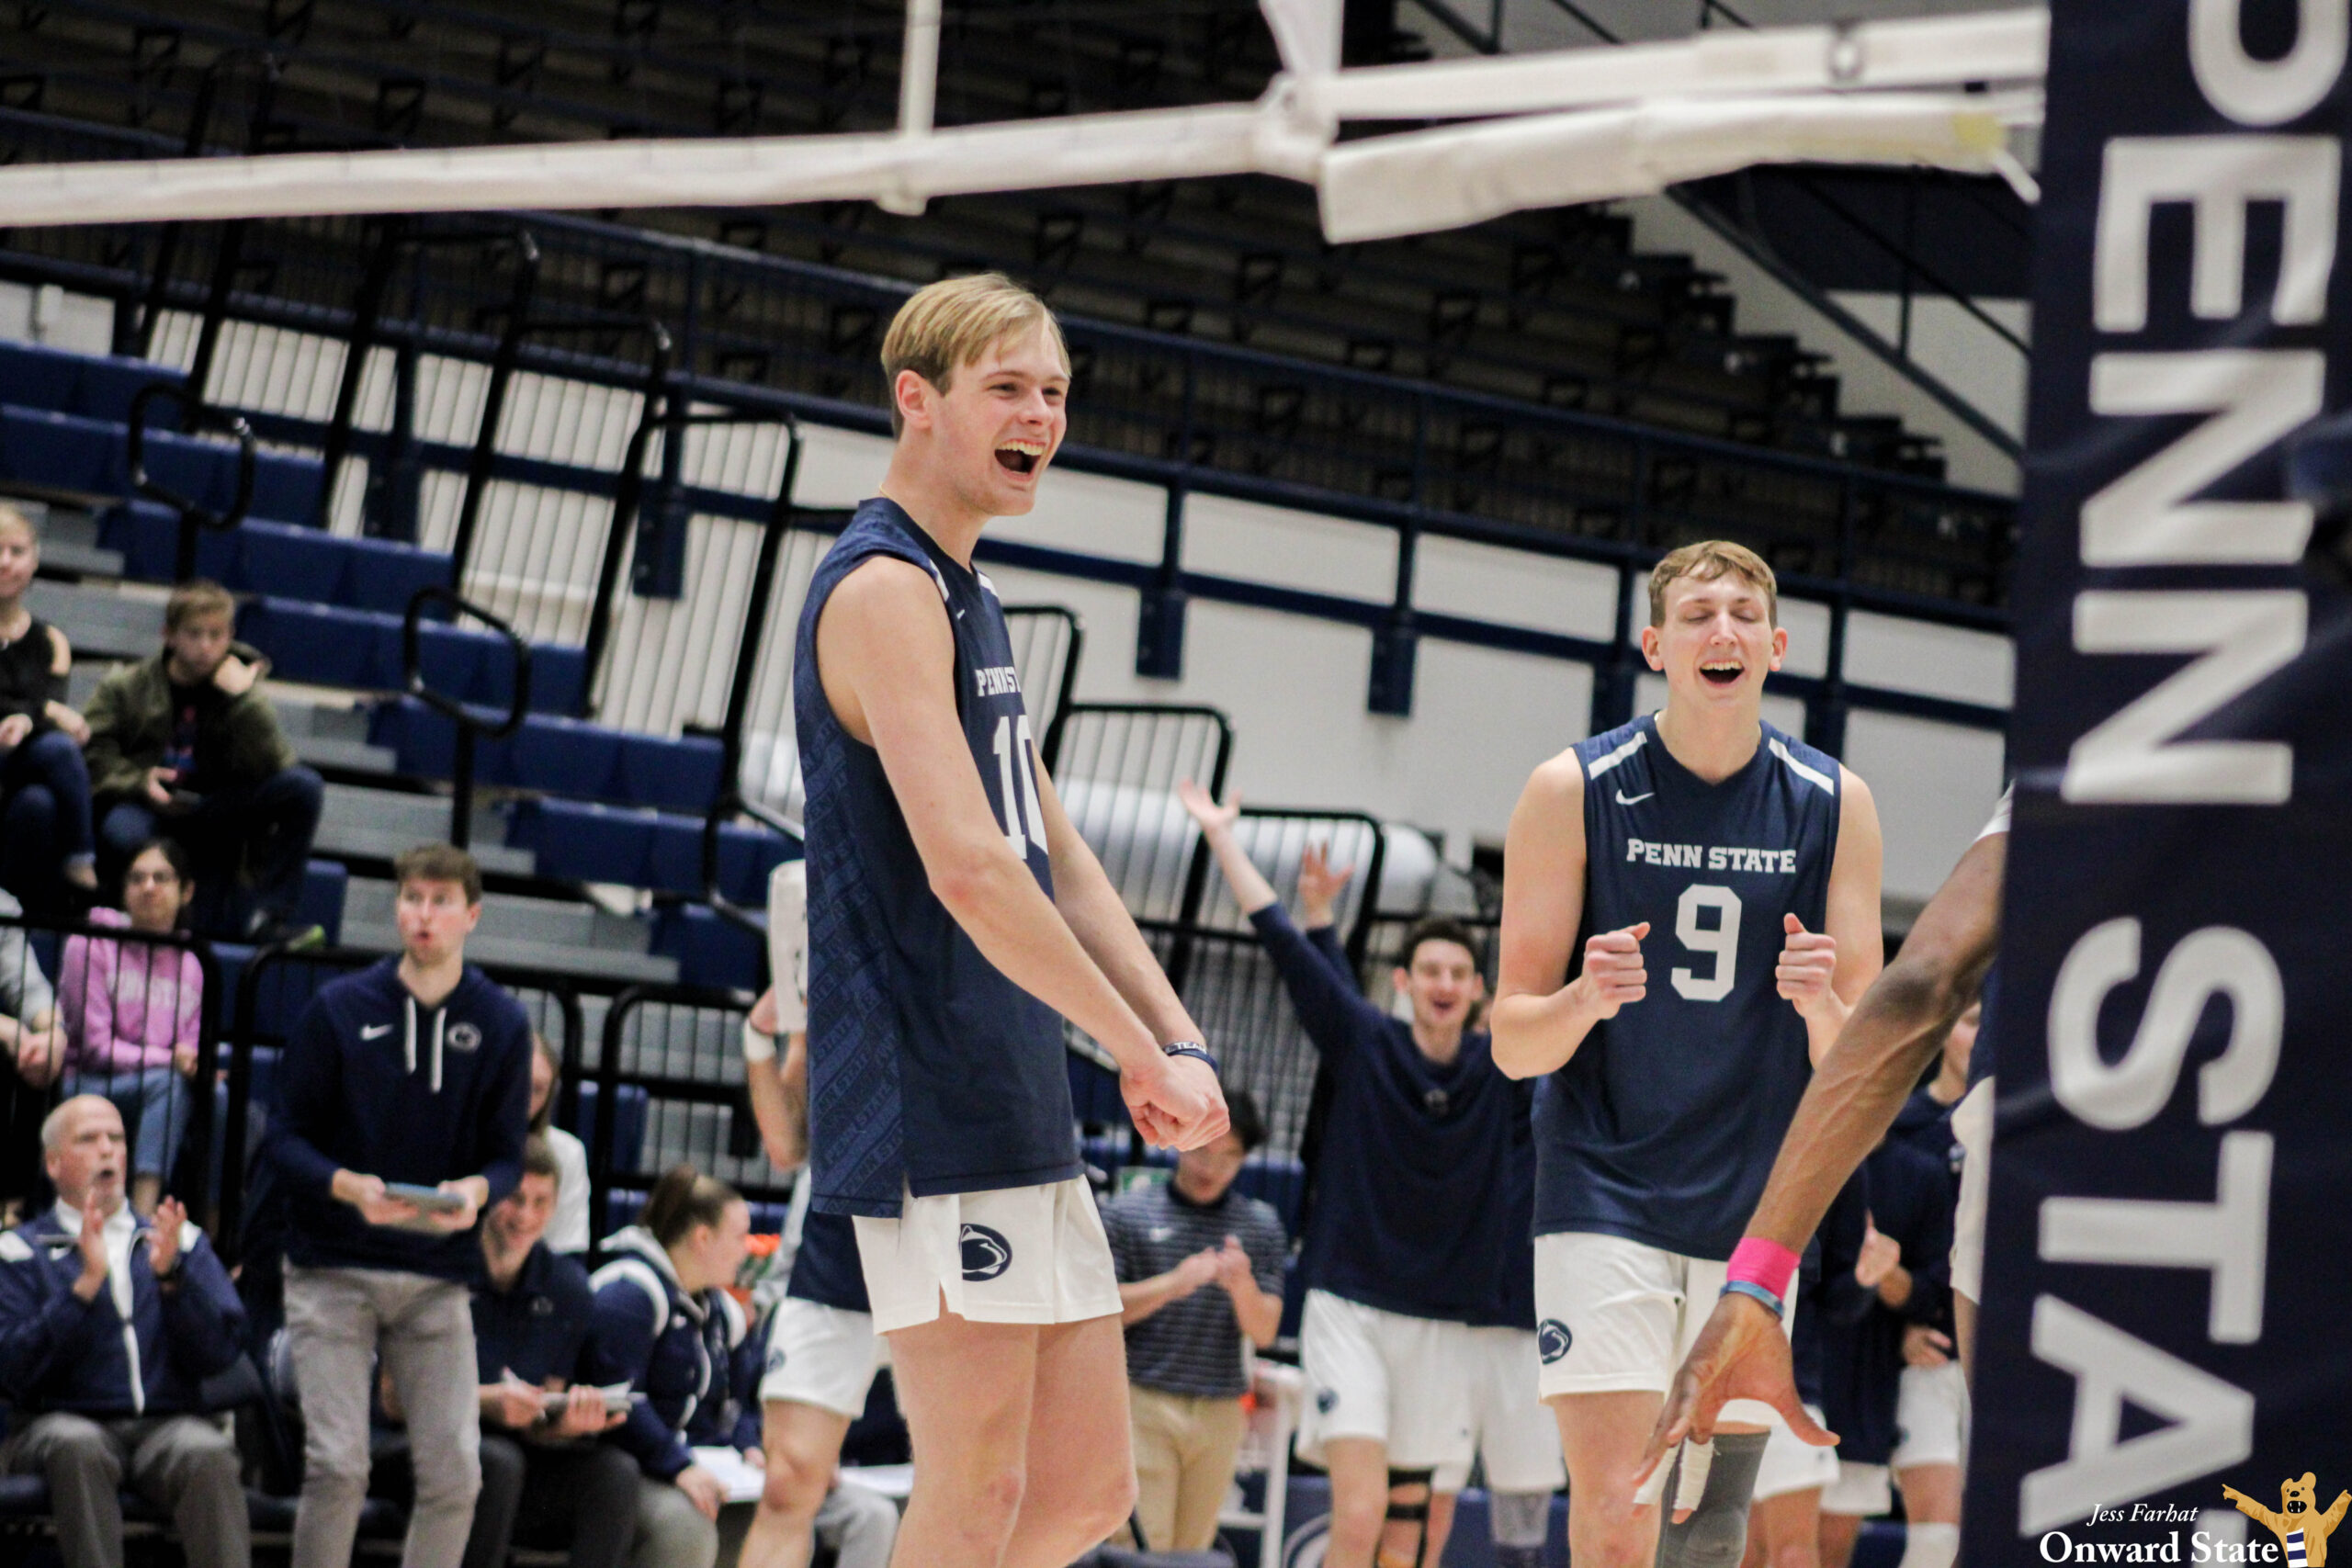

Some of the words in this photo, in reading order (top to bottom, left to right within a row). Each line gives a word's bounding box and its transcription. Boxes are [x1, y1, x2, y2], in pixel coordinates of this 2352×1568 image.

[1626, 838, 1702, 868] PENN
[1708, 846, 1796, 874] STATE
[1670, 883, 1742, 1002] 9
[2018, 917, 2286, 1568] STA
